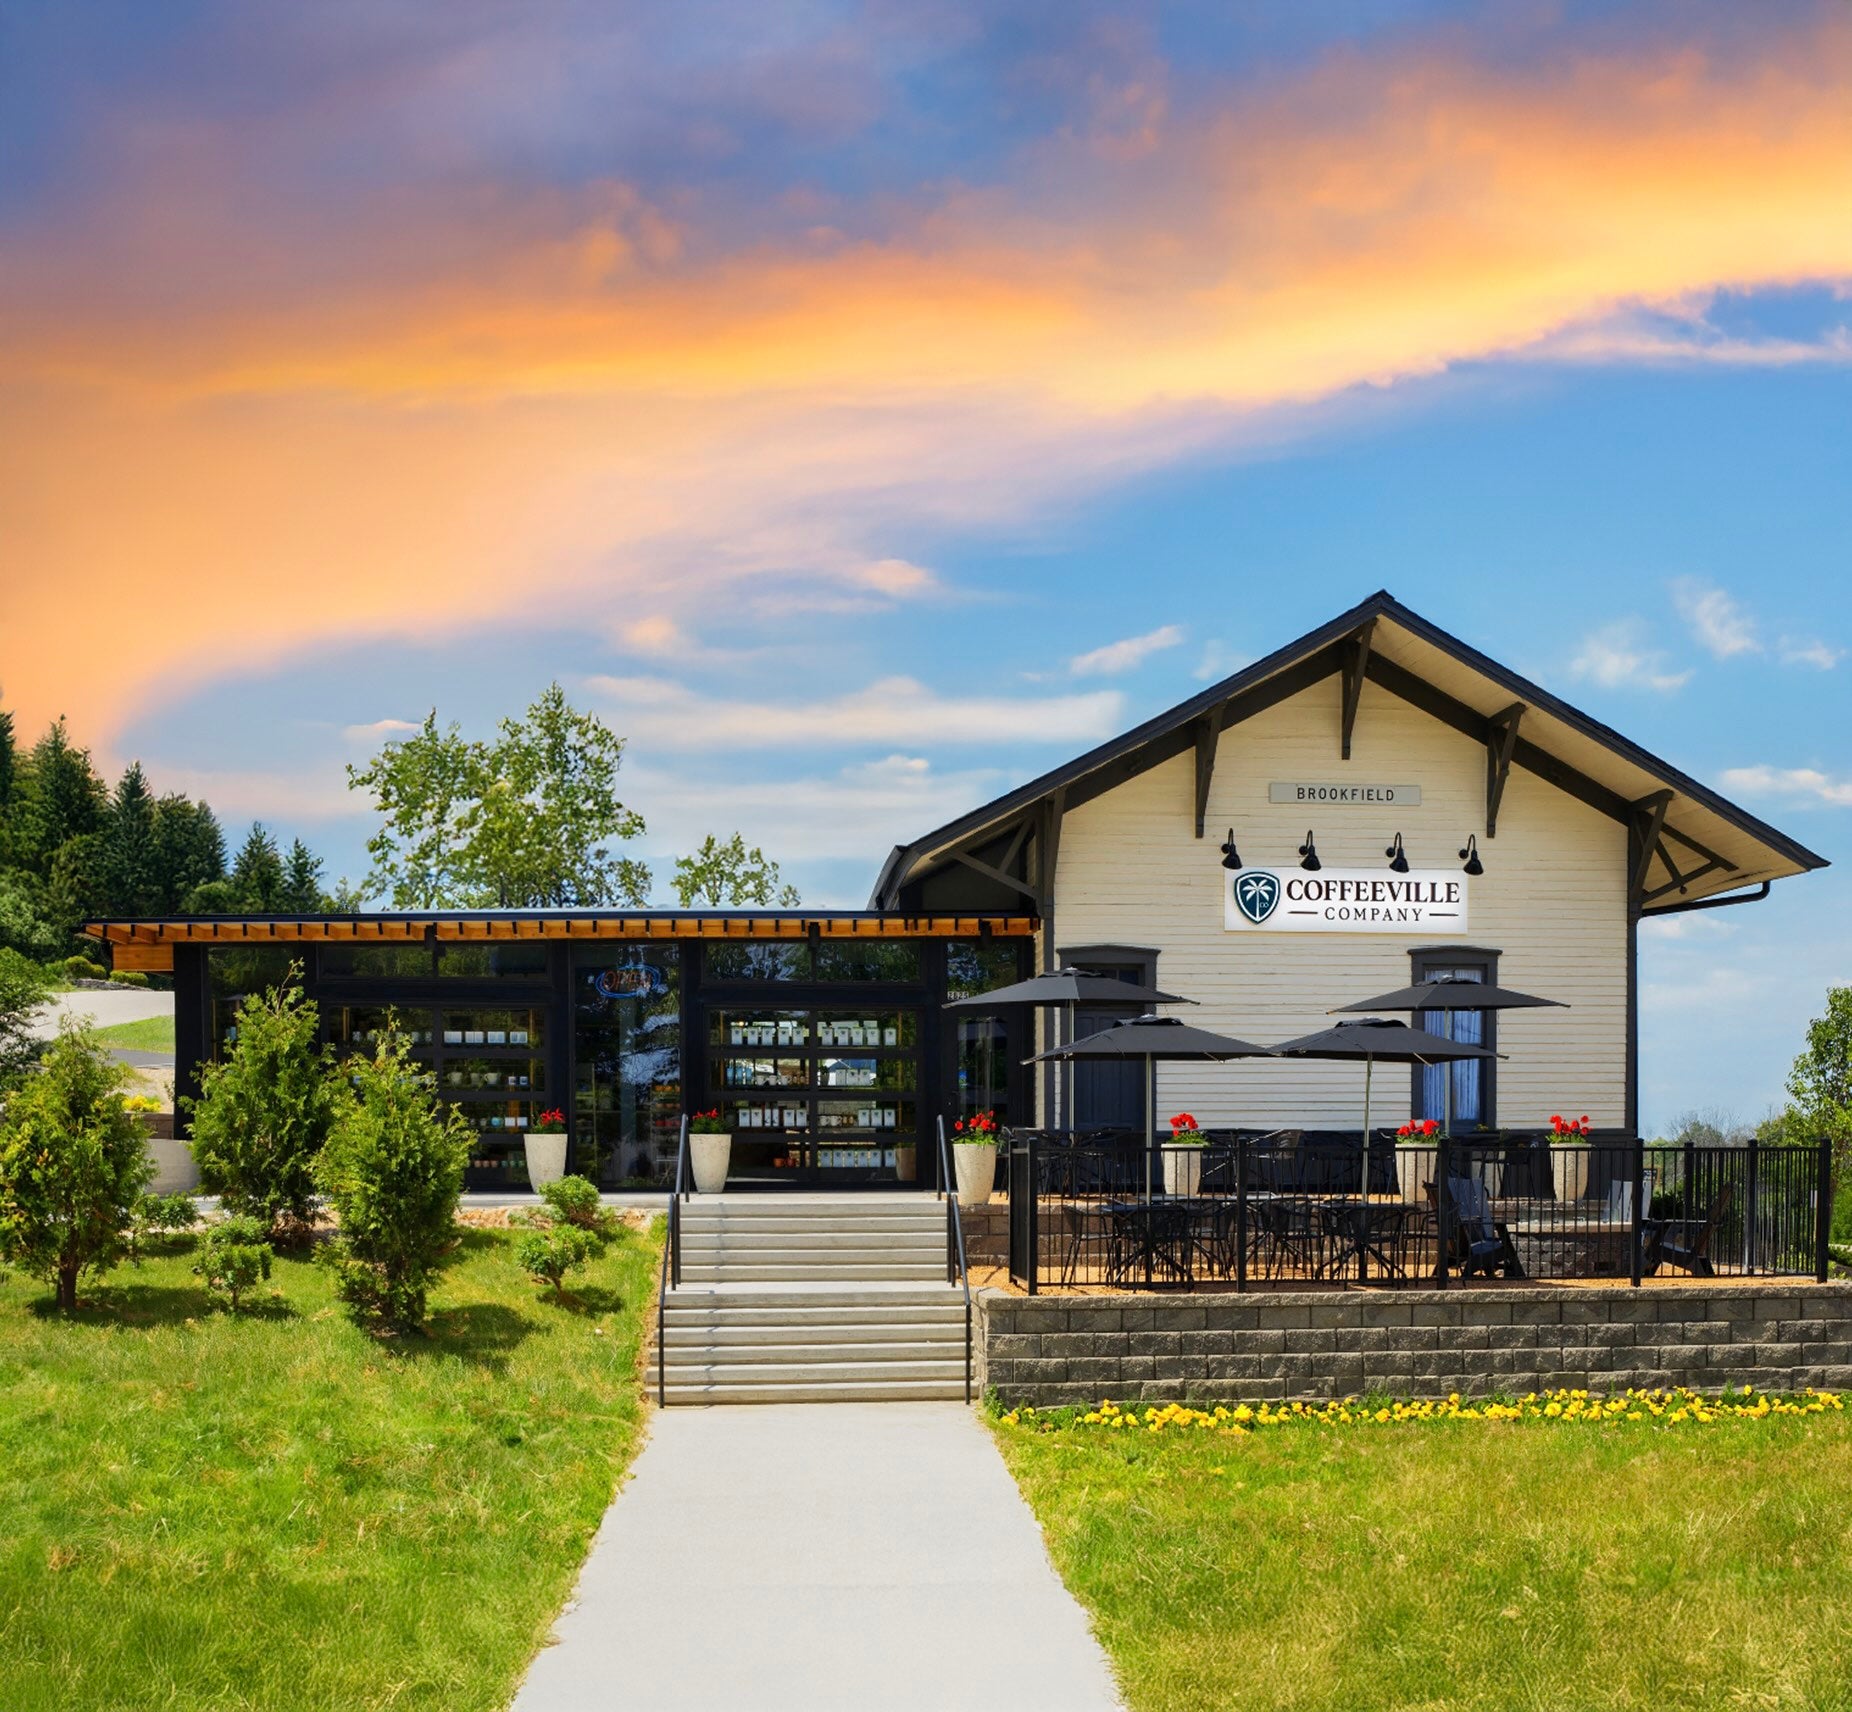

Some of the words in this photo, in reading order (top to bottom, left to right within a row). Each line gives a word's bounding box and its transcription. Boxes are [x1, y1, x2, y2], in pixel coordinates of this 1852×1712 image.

[1297, 787, 1394, 801] BROOKFIELD
[1286, 879, 1460, 903] COFFEEVILLE
[1324, 907, 1423, 922] COMPANY
